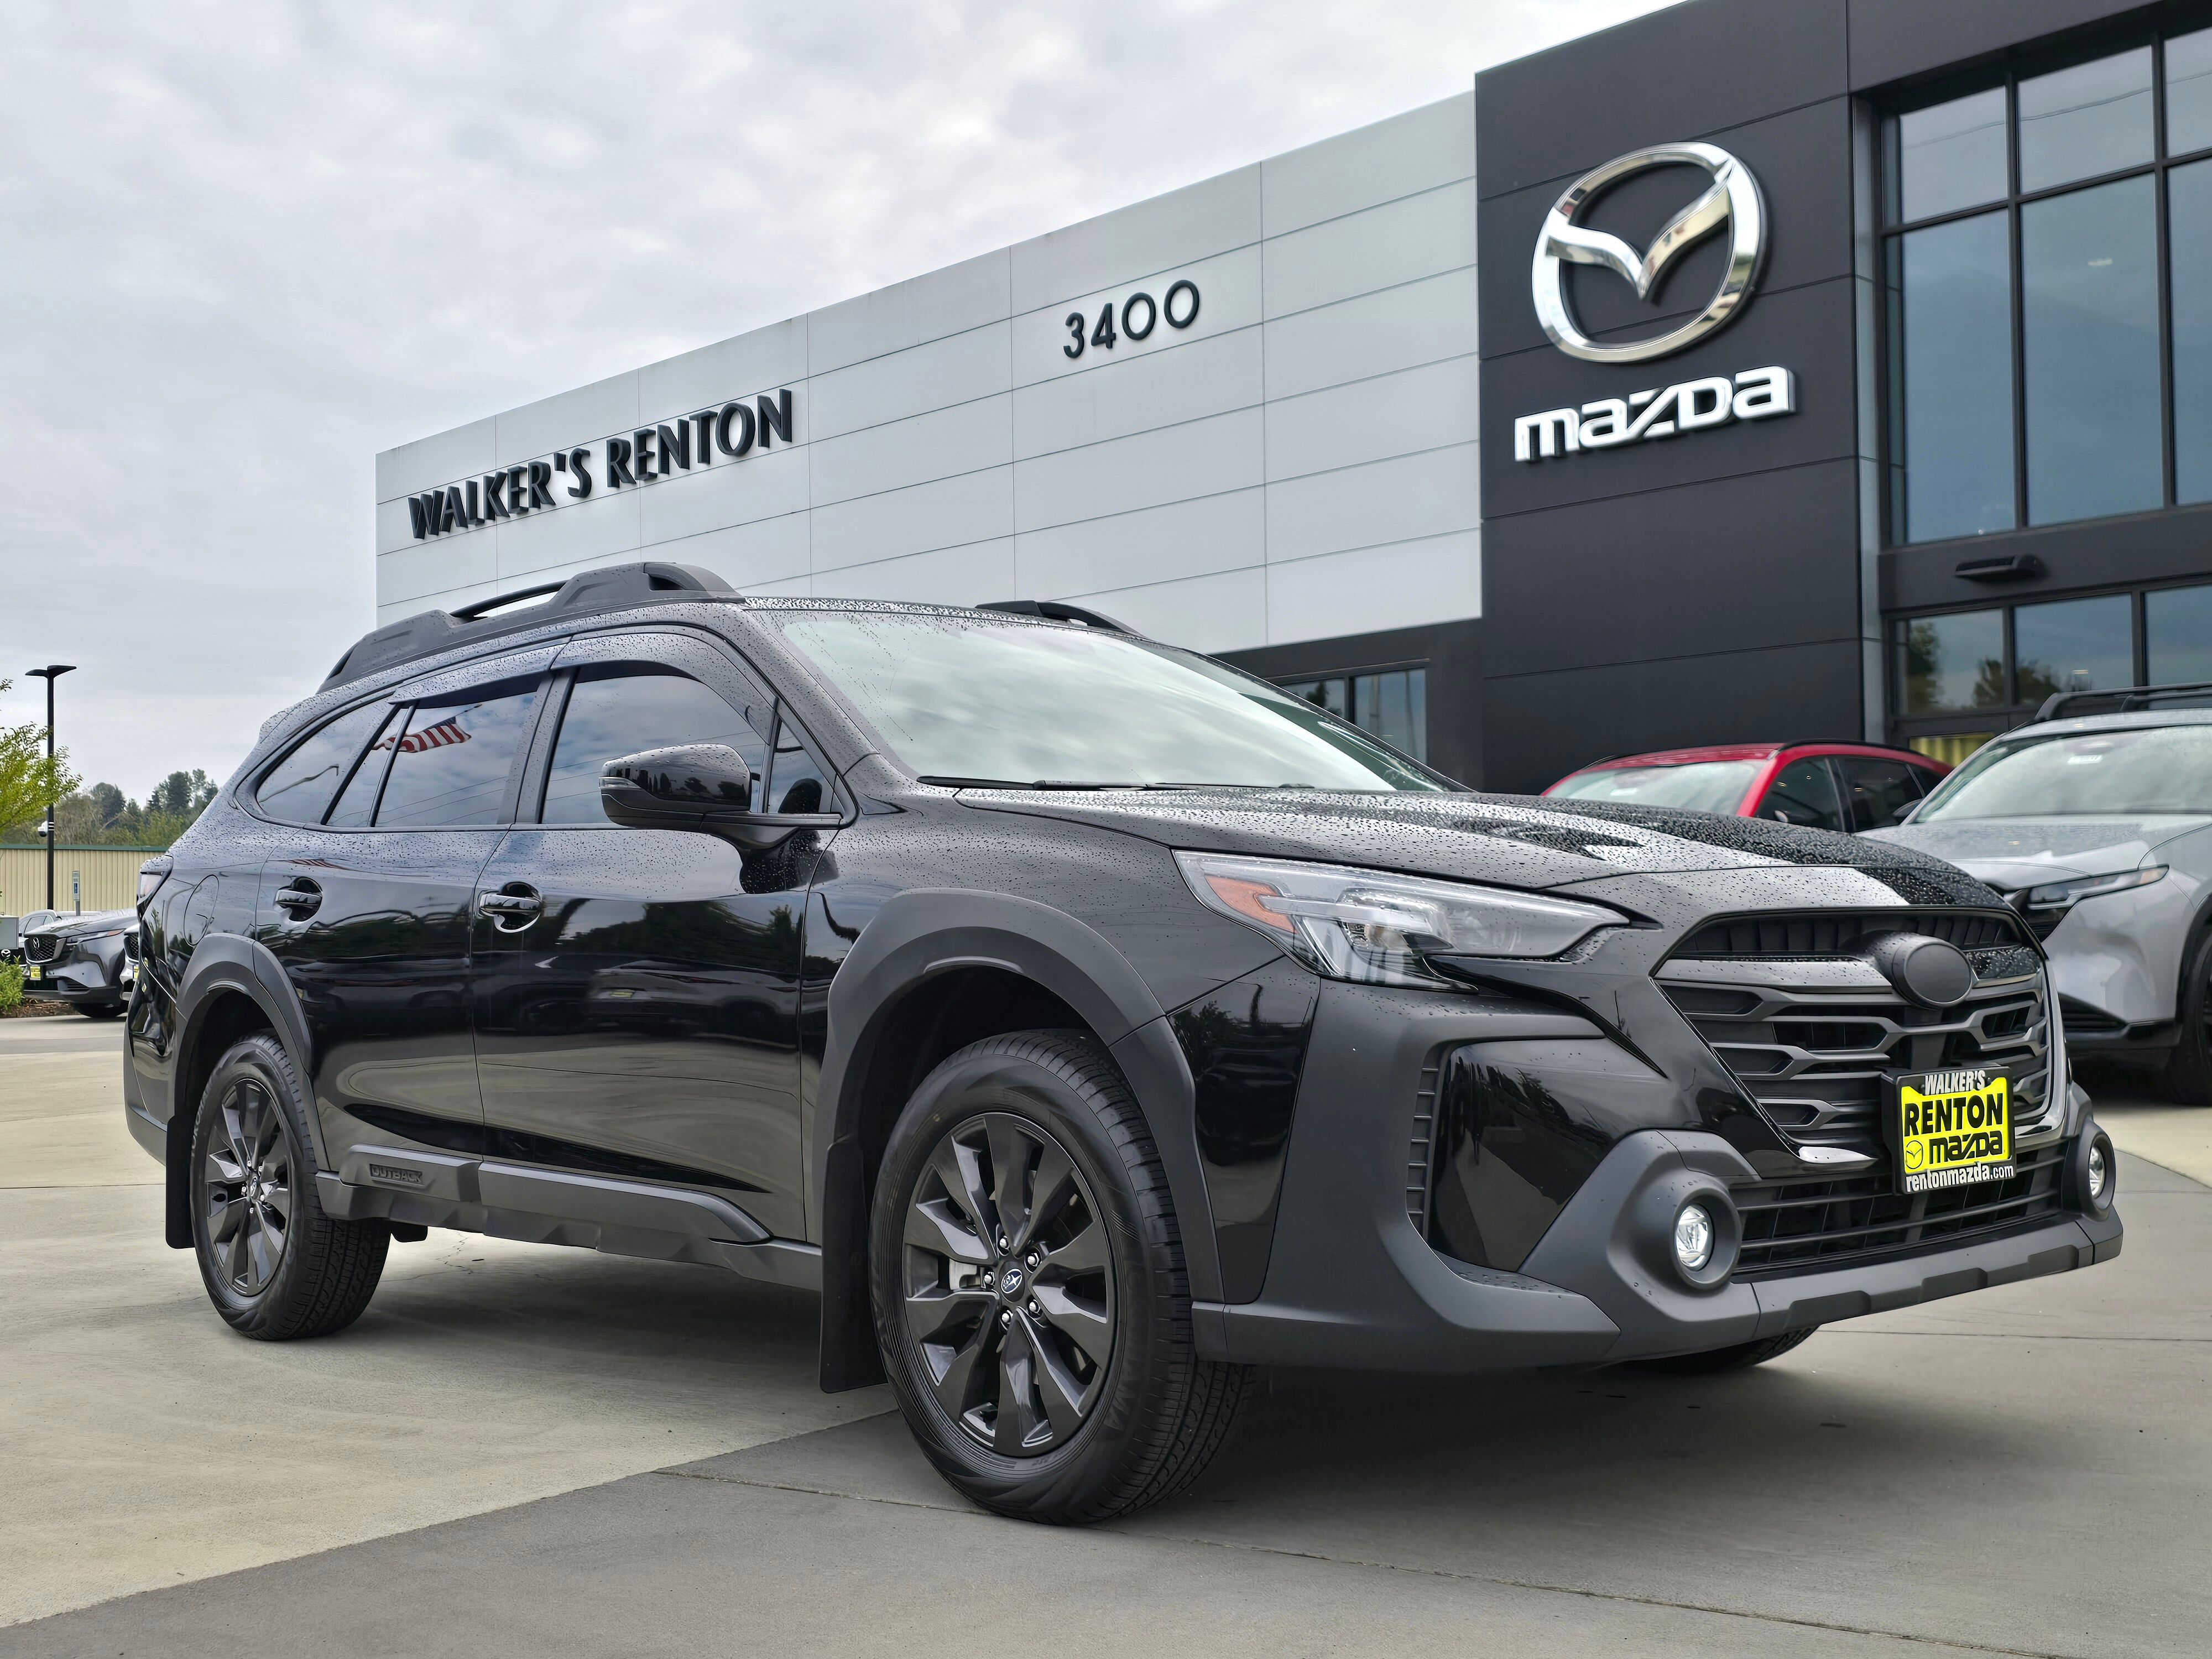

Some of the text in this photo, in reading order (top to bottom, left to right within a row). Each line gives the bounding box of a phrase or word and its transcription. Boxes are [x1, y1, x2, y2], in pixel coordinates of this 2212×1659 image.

[1063, 279, 1200, 359] 3400
[408, 388, 792, 539] WALKER'S RENTON
[1924, 1070, 1986, 1095] WALKER'S
[1904, 1093, 2004, 1137] RENTON
[371, 1165, 422, 1182] OUTBACK
[1906, 1161, 2014, 1192] rentonmazda.com
